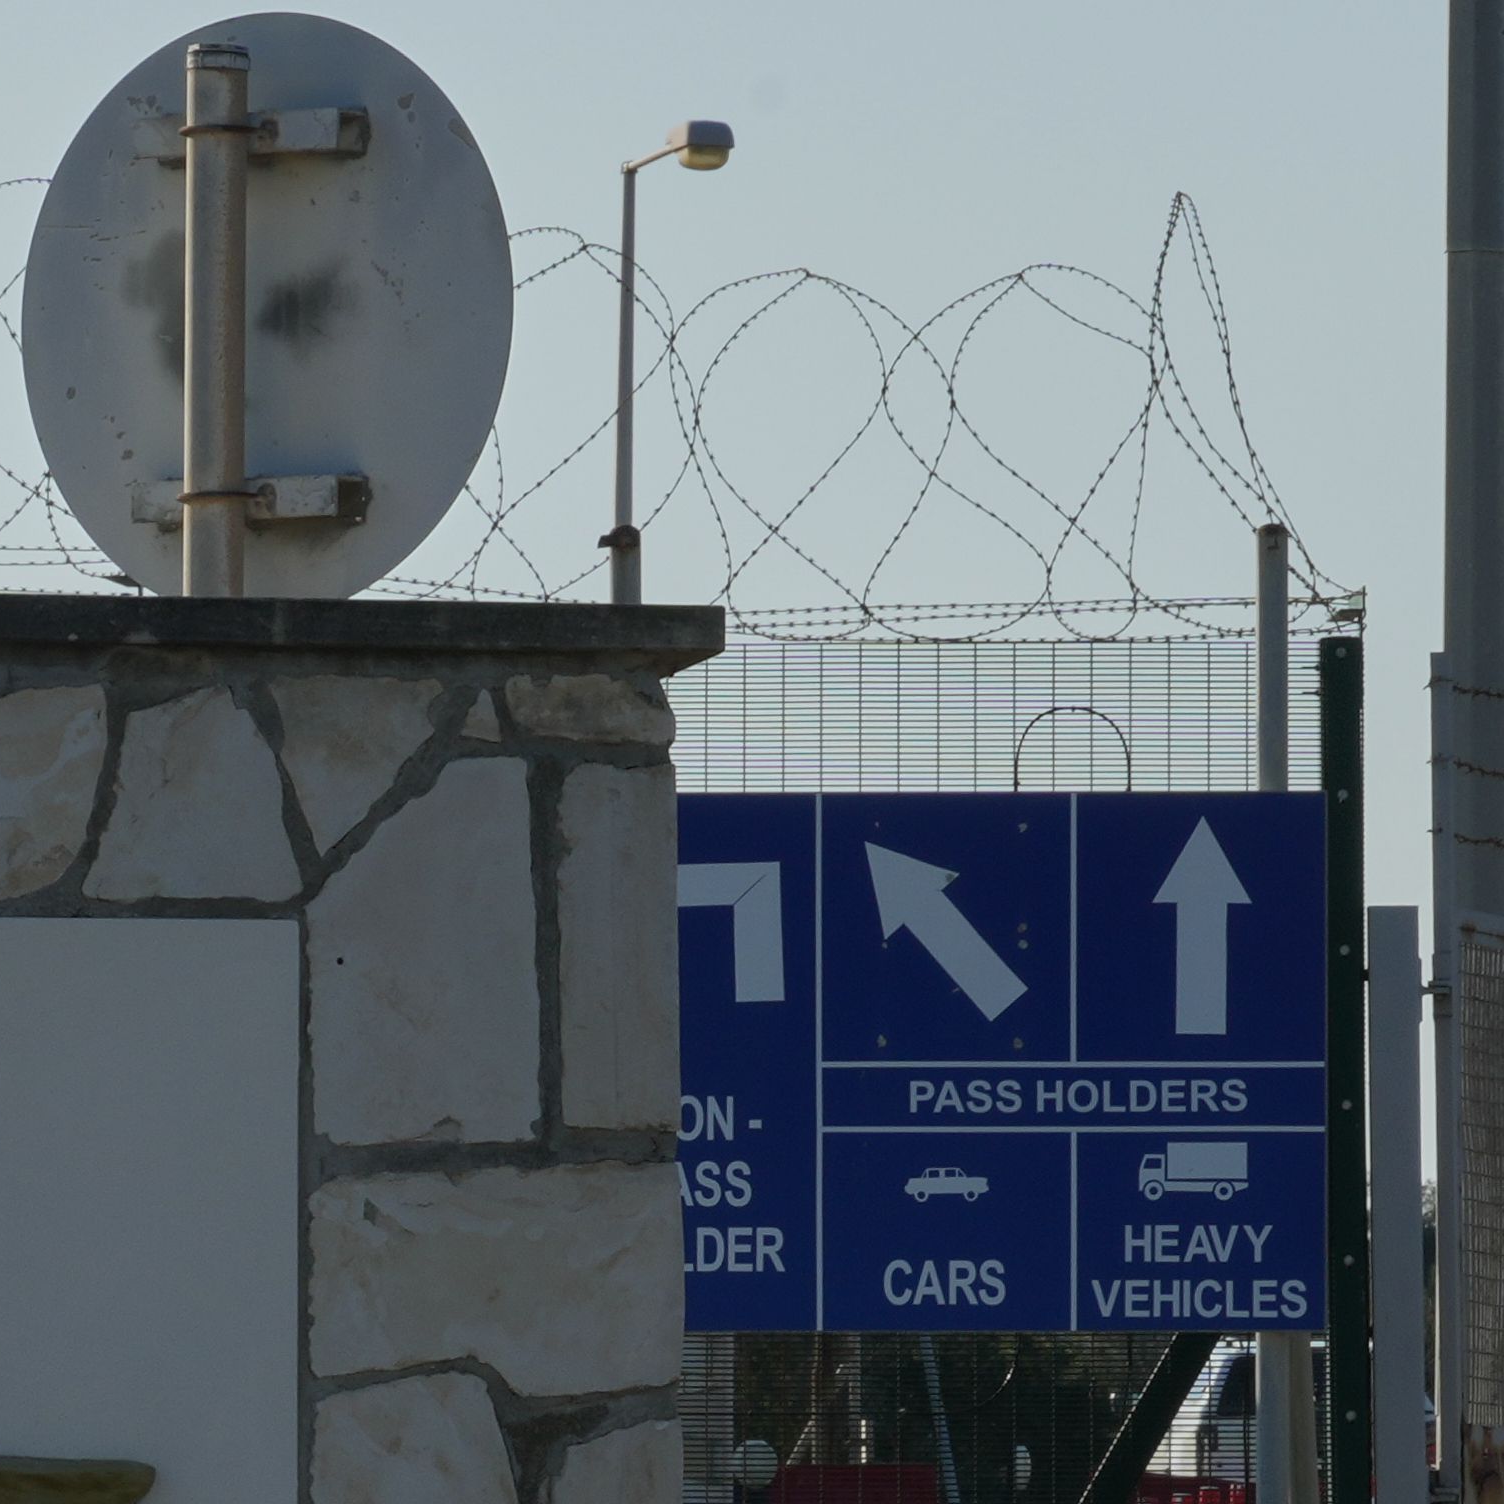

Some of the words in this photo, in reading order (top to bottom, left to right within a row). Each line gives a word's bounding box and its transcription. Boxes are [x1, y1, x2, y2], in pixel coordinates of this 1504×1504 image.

[909, 1080, 1022, 1113] PASS
[1036, 1079, 1248, 1112] HOLDERS
[676, 1095, 734, 1142] ON
[1124, 1225, 1273, 1263] HEAVY
[883, 1259, 1006, 1306] CARS
[1092, 1279, 1308, 1318] VEHICLES
